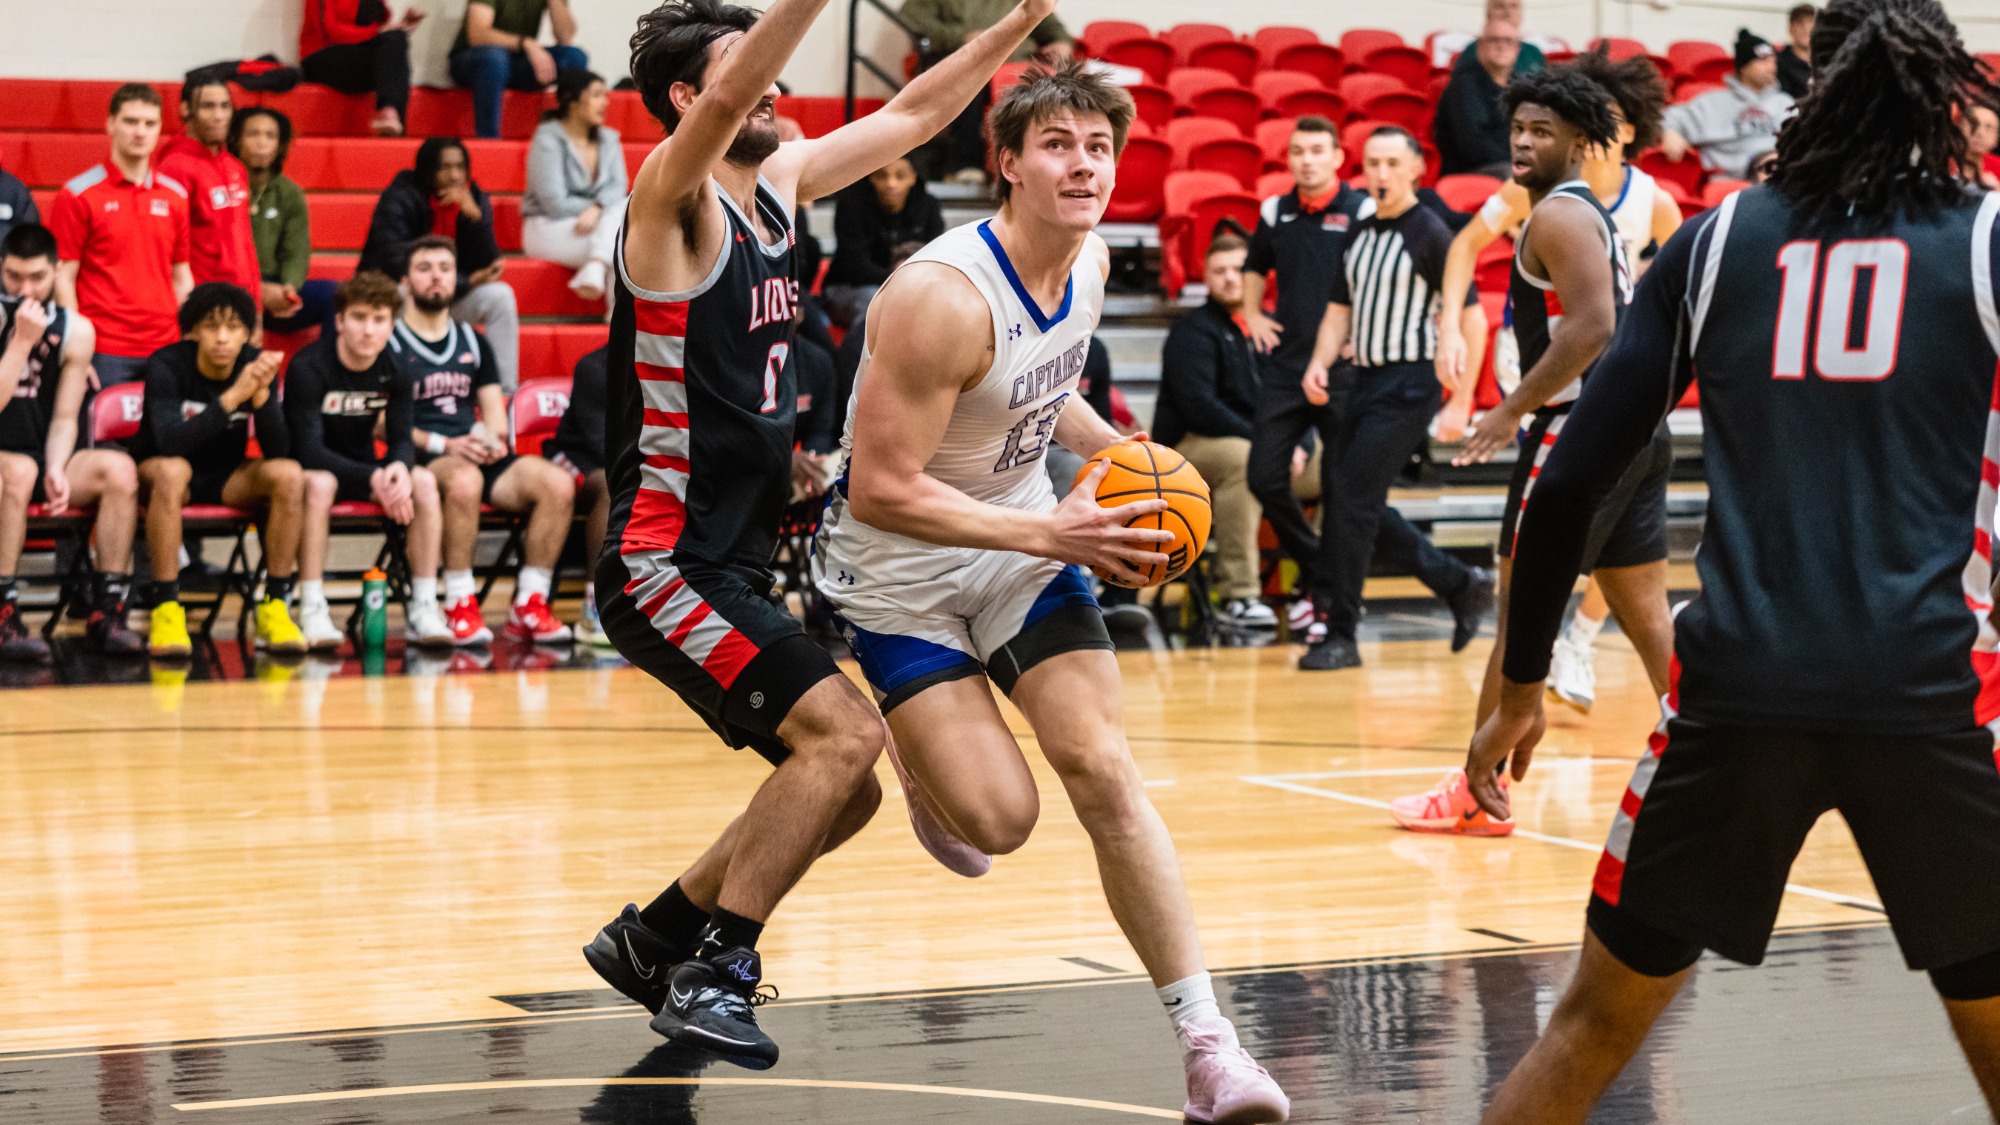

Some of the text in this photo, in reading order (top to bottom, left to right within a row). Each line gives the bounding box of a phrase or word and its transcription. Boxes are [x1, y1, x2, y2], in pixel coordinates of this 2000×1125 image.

[1771, 237, 1910, 382] 10
[1009, 339, 1085, 410] CAPTAINS
[993, 392, 1071, 473] 13
